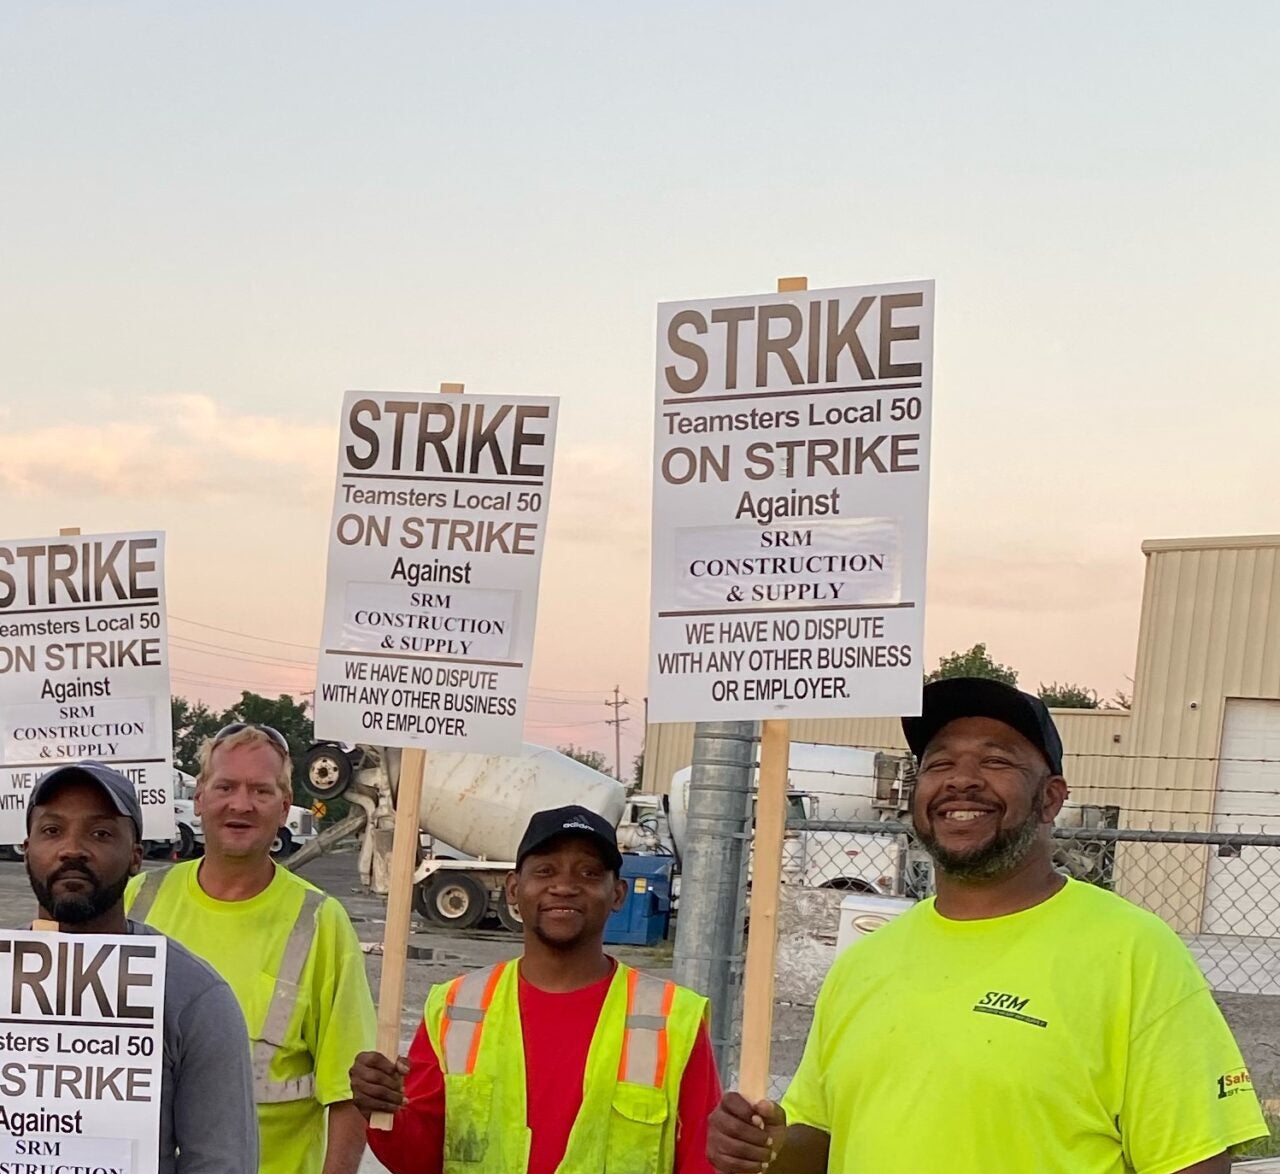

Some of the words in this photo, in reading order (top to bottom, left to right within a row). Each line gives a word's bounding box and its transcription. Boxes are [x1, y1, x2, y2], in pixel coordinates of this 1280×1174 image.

[665, 292, 923, 394] STRIKE
[663, 402, 799, 434] Teamsters
[809, 399, 881, 426] Local
[890, 397, 921, 421] 50
[346, 399, 549, 476] STRIKE
[662, 445, 730, 484] ON
[744, 434, 920, 480] STRIKE
[342, 484, 446, 507] Teamsters
[453, 489, 511, 510] Local
[517, 493, 541, 512] 50
[735, 488, 840, 526] Against
[337, 514, 391, 547] ON
[400, 517, 538, 555] STRIKE
[761, 531, 811, 547] SRM
[391, 557, 471, 587] Against
[690, 554, 884, 577] CONSTRUCTION
[411, 593, 450, 608] SRM
[727, 586, 743, 602] &
[752, 583, 844, 601] SUPPLY
[86, 613, 134, 632] Local
[140, 612, 160, 629] 50
[355, 611, 504, 634] CONSTRUCTION
[686, 623, 715, 644] WE
[720, 621, 768, 643] HAVE
[773, 620, 799, 641] NO
[805, 617, 884, 640] DISPUTE
[45, 638, 161, 671] STRIKE
[381, 635, 394, 648] &
[400, 636, 472, 655] SUPPLY
[658, 652, 702, 674] WITH
[706, 651, 744, 672] ANY
[749, 649, 812, 671] OTHER
[818, 645, 911, 669] BUSINESS
[346, 662, 367, 680] WE
[371, 664, 408, 683] HAVE
[411, 667, 433, 685] NO
[436, 668, 498, 690] DISPUTE
[41, 677, 111, 703] Against
[323, 684, 356, 703] WITH
[359, 687, 389, 705] ANY
[392, 689, 440, 710] OTHER
[444, 693, 516, 716] BUSINESS
[712, 680, 739, 701] OR
[744, 677, 850, 700] EMPLOYER.
[60, 706, 94, 719] SRM
[362, 711, 383, 729] OR
[387, 713, 467, 736] EMPLOYER.
[14, 723, 143, 740] CONSTRUCTION
[40, 746, 51, 758] &
[57, 743, 118, 757] SUPPLY
[11, 773, 31, 789] WE
[979, 991, 1031, 1012] SRM
[57, 1033, 119, 1055] Local
[127, 1036, 153, 1056] 50
[0, 1063, 152, 1102] STRIKE
[16, 1140, 60, 1156] SRM
